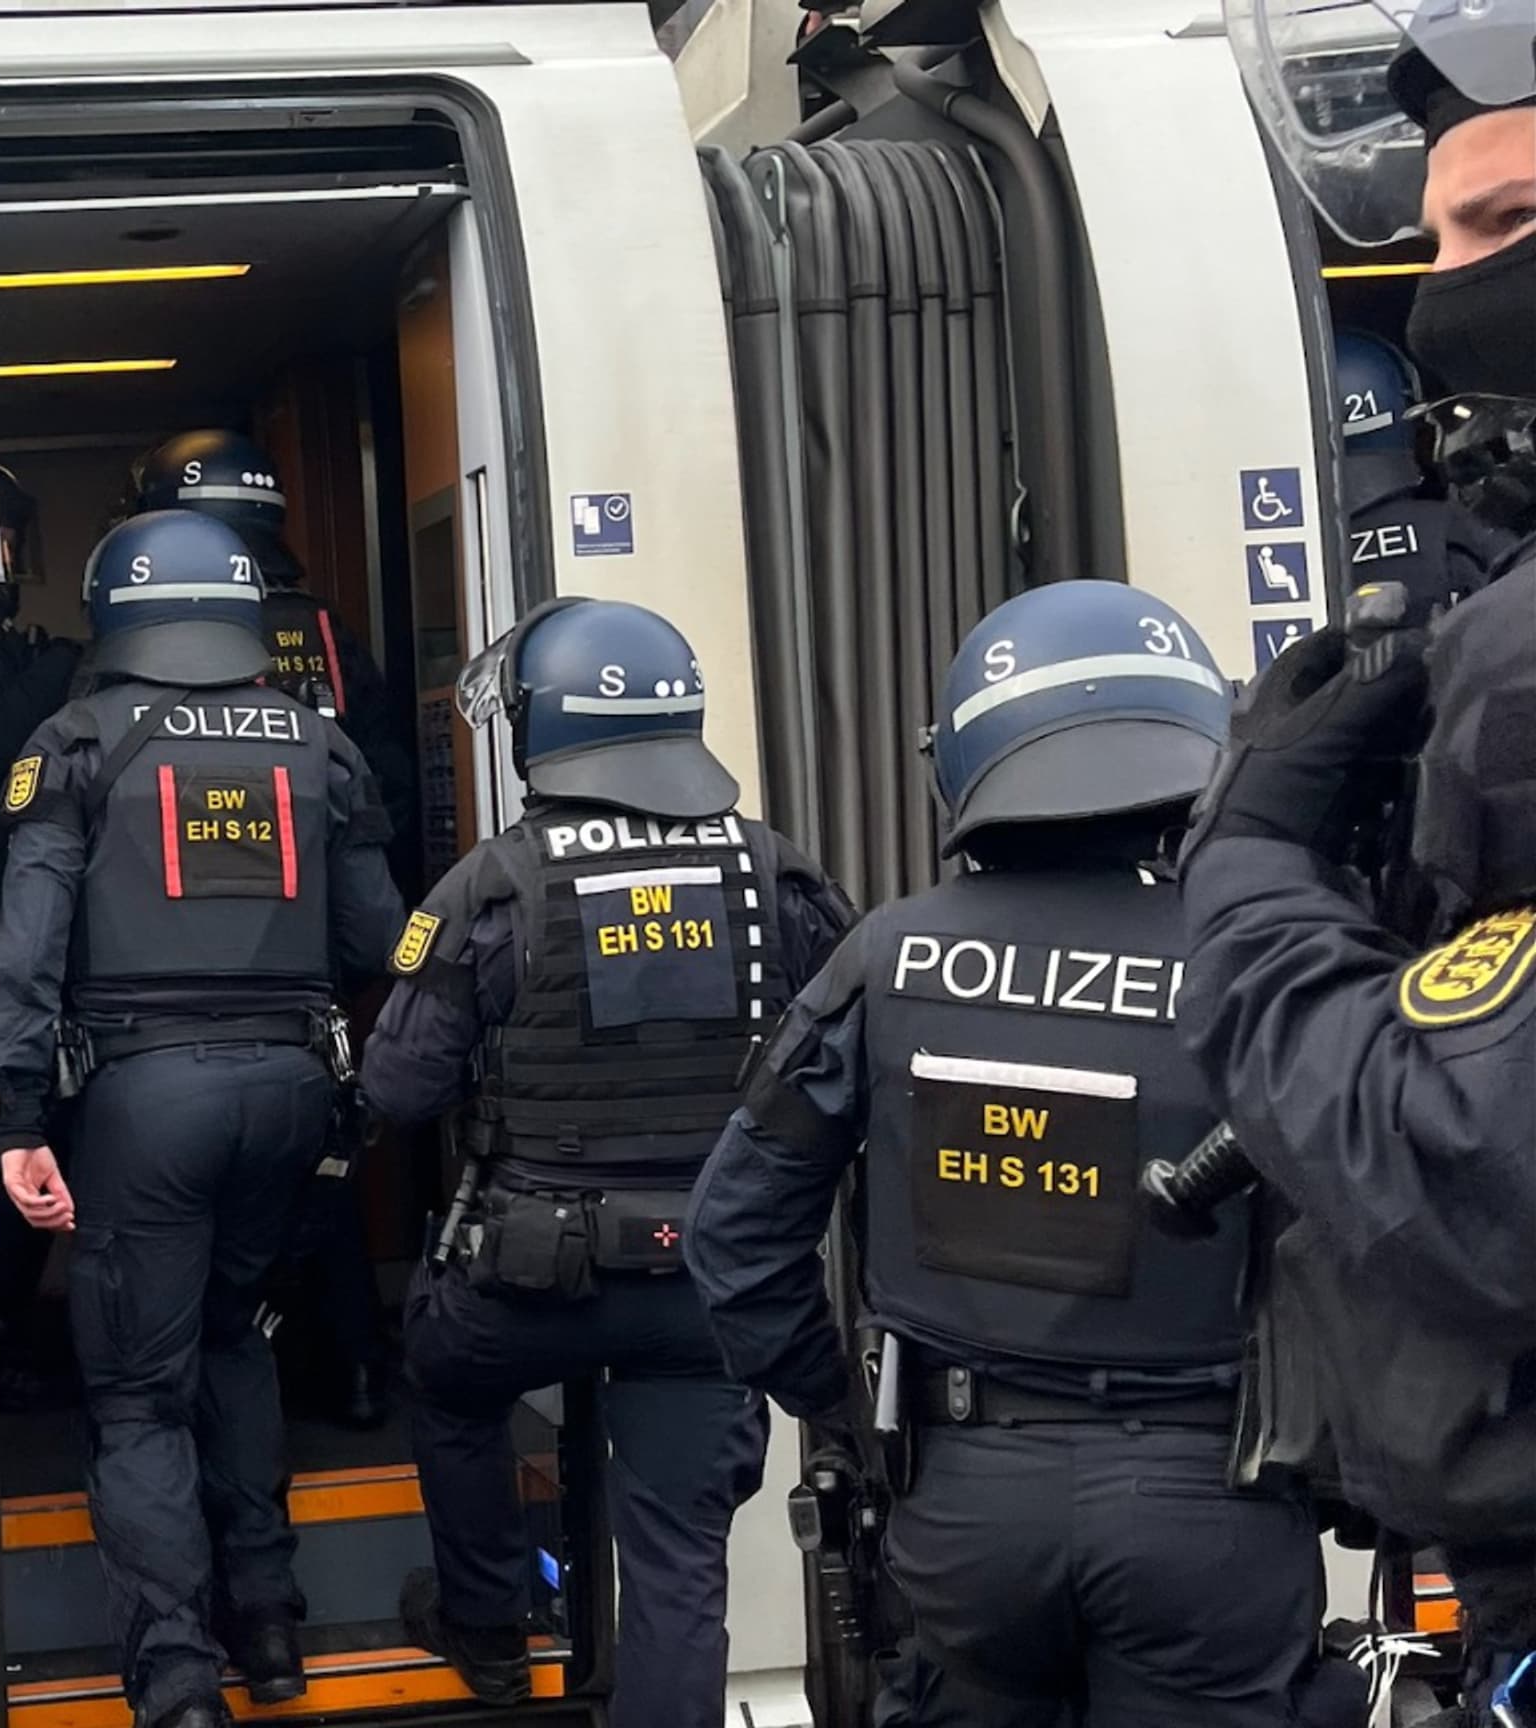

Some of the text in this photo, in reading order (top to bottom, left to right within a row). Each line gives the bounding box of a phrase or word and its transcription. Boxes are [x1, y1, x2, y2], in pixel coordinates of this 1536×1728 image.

[1344, 389, 1378, 422] 21
[183, 461, 202, 485] S
[1350, 524, 1419, 563] ZEI
[130, 554, 251, 584] S 21
[276, 631, 304, 648] BW
[1138, 616, 1192, 660] 31
[272, 655, 325, 672] H S 12
[983, 639, 1016, 683] S
[598, 664, 626, 697] S
[207, 789, 247, 810] BW
[186, 821, 272, 842] EH S 12
[547, 816, 744, 857] POLIZEI
[629, 885, 673, 916] BW
[597, 919, 714, 956] EH S 131
[893, 935, 1185, 1020] POLIZEI
[983, 1103, 1049, 1140] BW
[938, 1149, 1100, 1198] EH S 131
